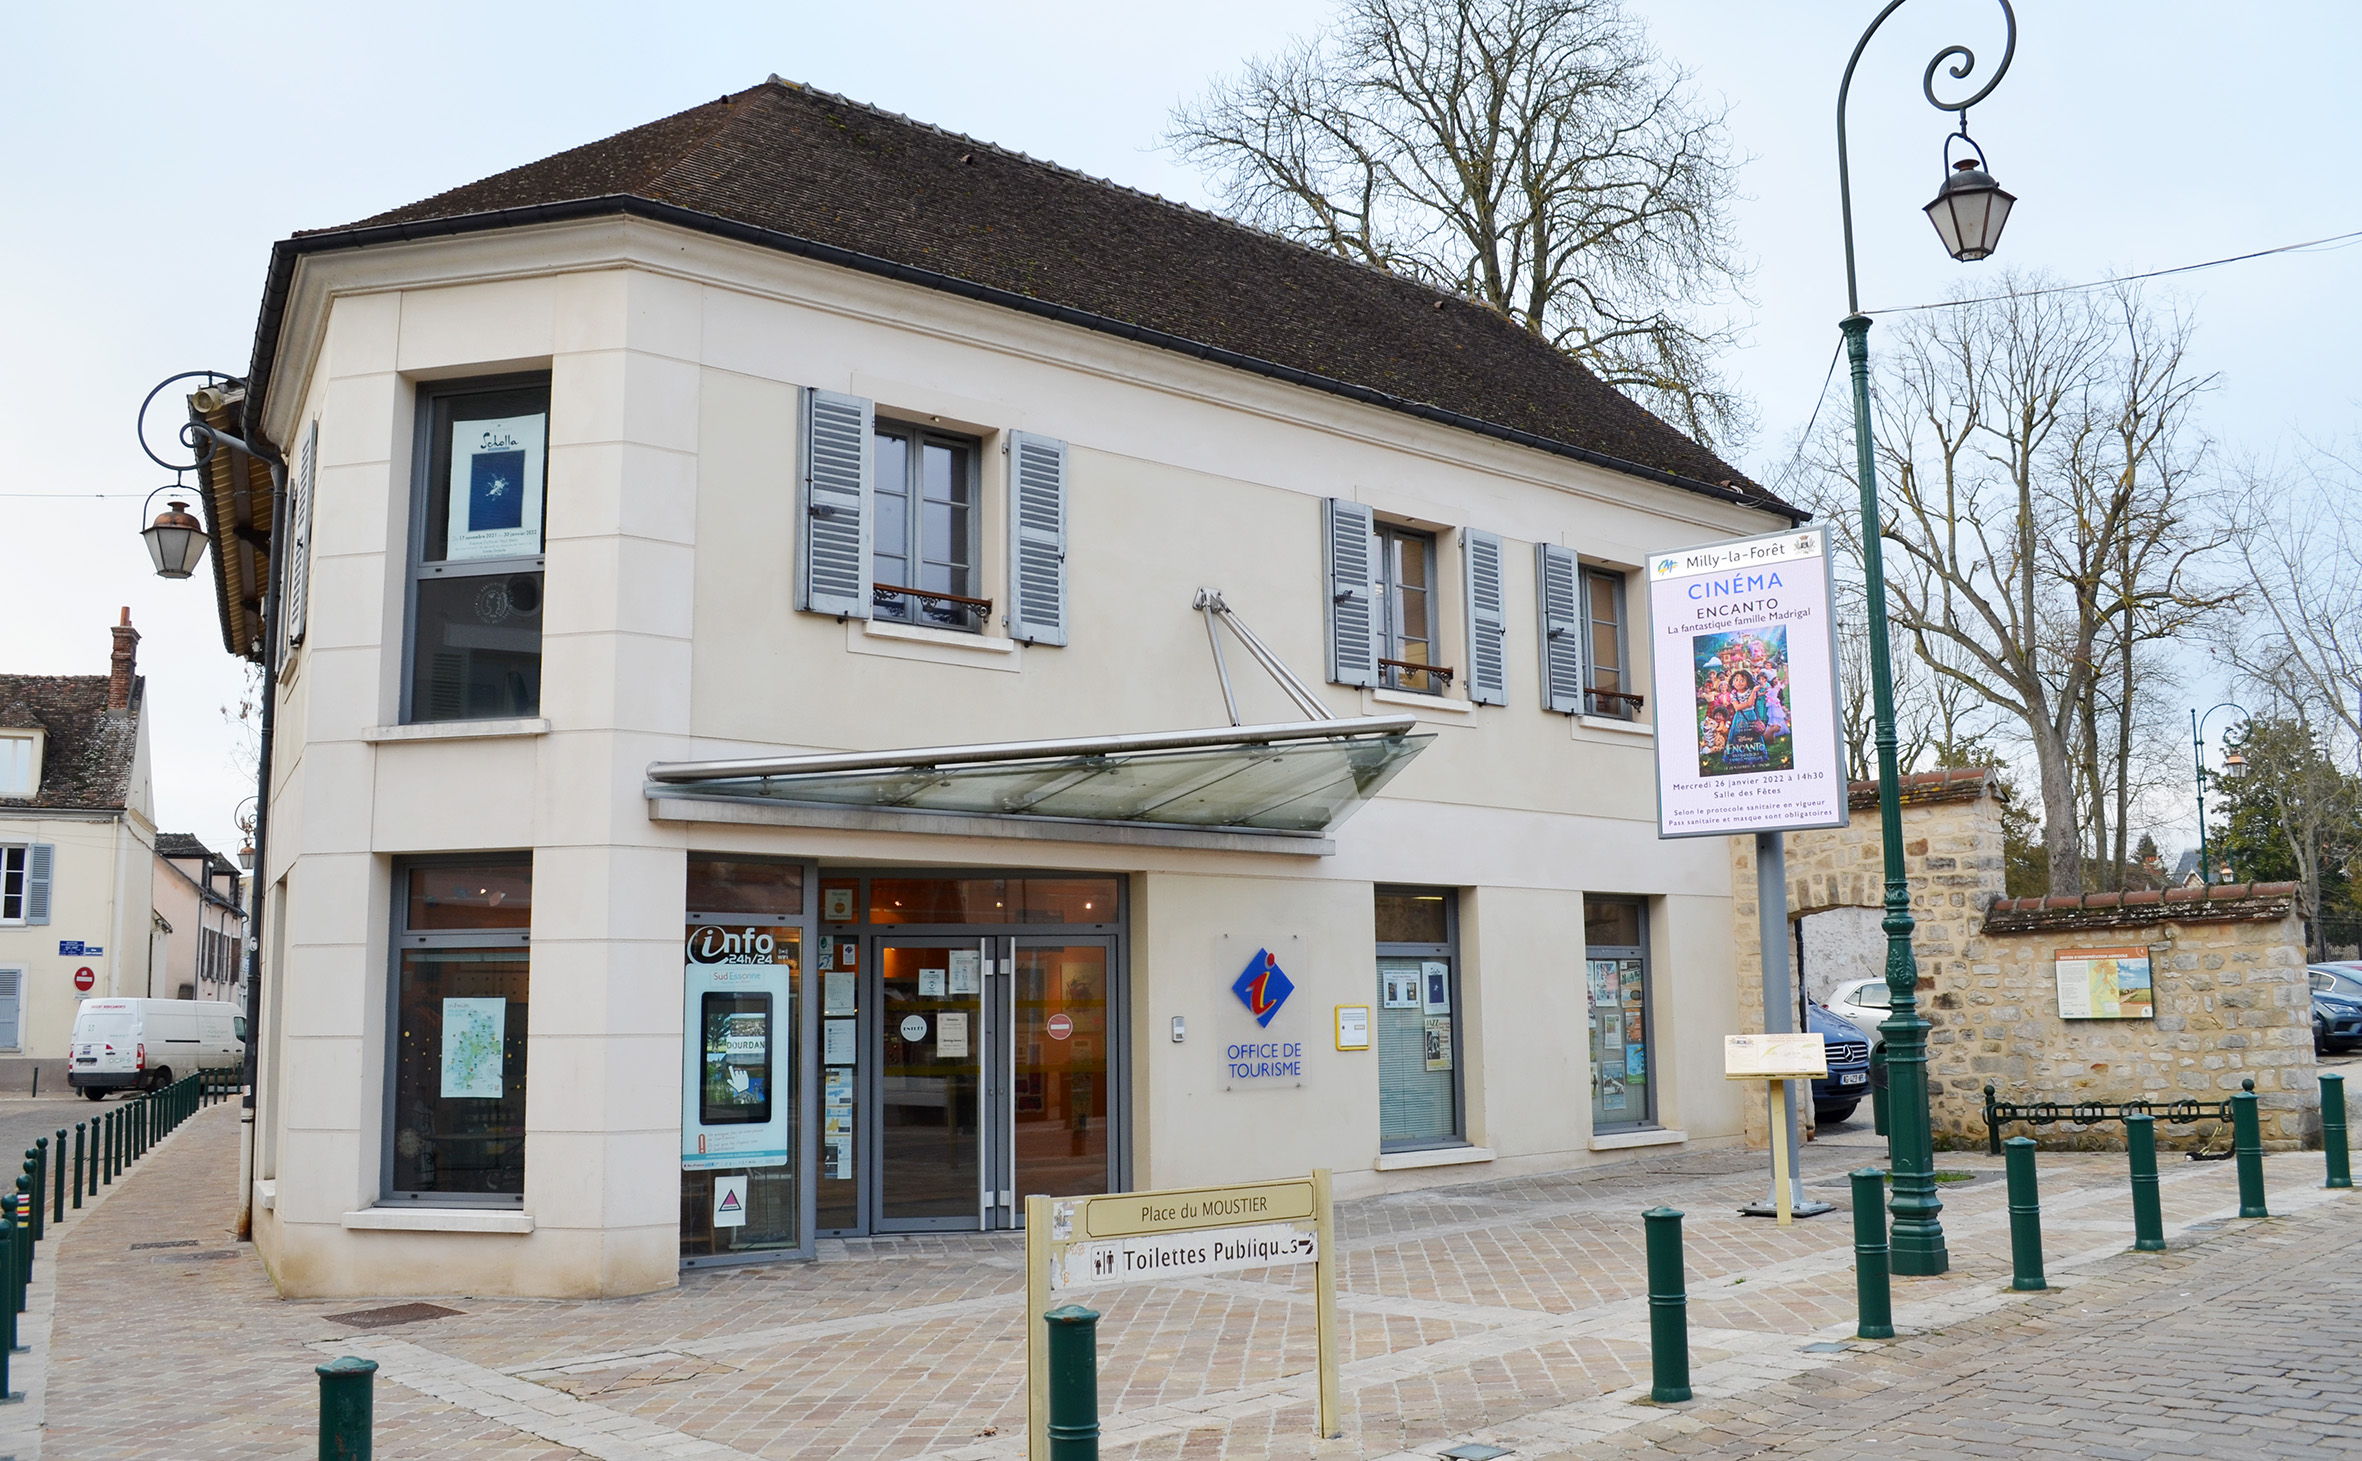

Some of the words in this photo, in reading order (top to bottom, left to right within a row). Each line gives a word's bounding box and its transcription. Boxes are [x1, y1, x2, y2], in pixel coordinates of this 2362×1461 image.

[1686, 542, 1785, 569] Milly-la-Forêt
[1688, 572, 1783, 600] CINÉMA
[1697, 598, 1779, 620] ENCANTO
[1668, 625, 1679, 635] La
[1681, 619, 1732, 632] fantastique
[1734, 614, 1766, 625] famille
[1769, 607, 1811, 621] Madrigal
[1673, 781, 1712, 791] Mercredi
[1715, 780, 1725, 788] 26
[1728, 778, 1759, 788] janvier
[1763, 775, 1784, 784] 2022
[1787, 773, 1792, 781] à
[1797, 771, 1824, 780] 14h30
[1714, 790, 1735, 799] Salle
[1738, 789, 1754, 797] des
[1757, 787, 1781, 796] Fêtes
[1668, 819, 1685, 827] Pass
[1687, 817, 1720, 825] sanitaire
[1733, 814, 1762, 823] masque
[1784, 809, 1832, 819] obligatoires
[1674, 808, 1694, 817] Selon
[1697, 807, 1704, 815] le
[1706, 805, 1744, 816] protocole
[1746, 802, 1781, 811] sanitaire
[1795, 799, 1825, 809] vigueur
[687, 925, 774, 965] info
[728, 954, 773, 964] 24h/24
[726, 1041, 765, 1049] DOURDAN
[1227, 1044, 1278, 1060] OFFICE
[1283, 1043, 1302, 1058] DE
[1228, 1061, 1301, 1078] TOURISME
[1141, 1206, 1176, 1222] Place
[1180, 1203, 1197, 1218] du
[1202, 1197, 1268, 1216] MOUSTIER
[1123, 1247, 1206, 1271] Toilettes
[1214, 1239, 1298, 1261] Publiqus
